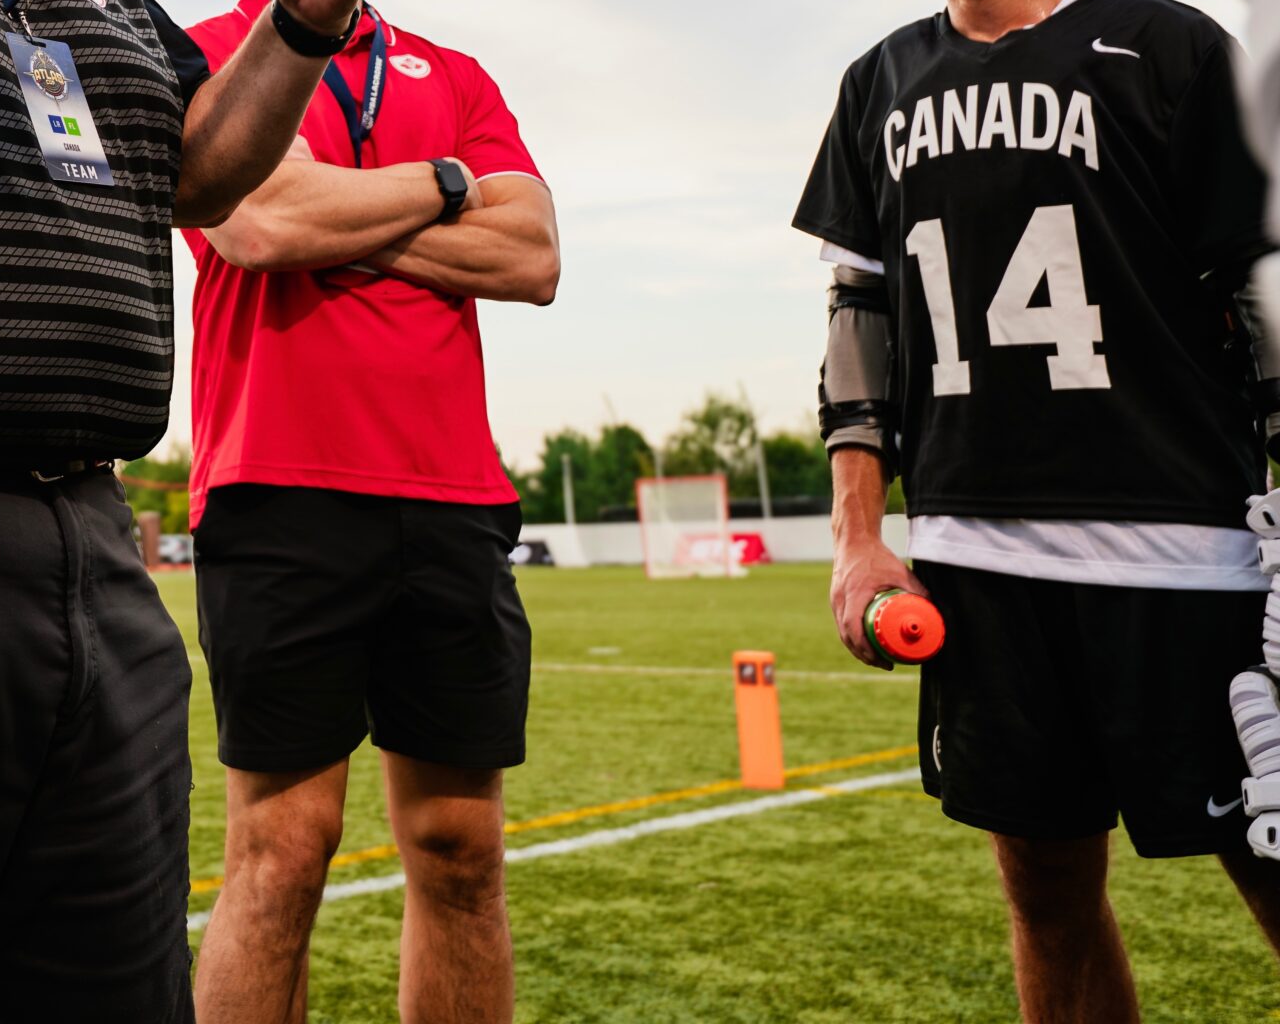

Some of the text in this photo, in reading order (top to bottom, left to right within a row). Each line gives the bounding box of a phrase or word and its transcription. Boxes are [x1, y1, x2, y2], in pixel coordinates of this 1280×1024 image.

[33, 68, 65, 85] ATLAS
[883, 81, 1100, 182] CANADA
[61, 162, 98, 180] TEAM
[904, 204, 1112, 398] 14
